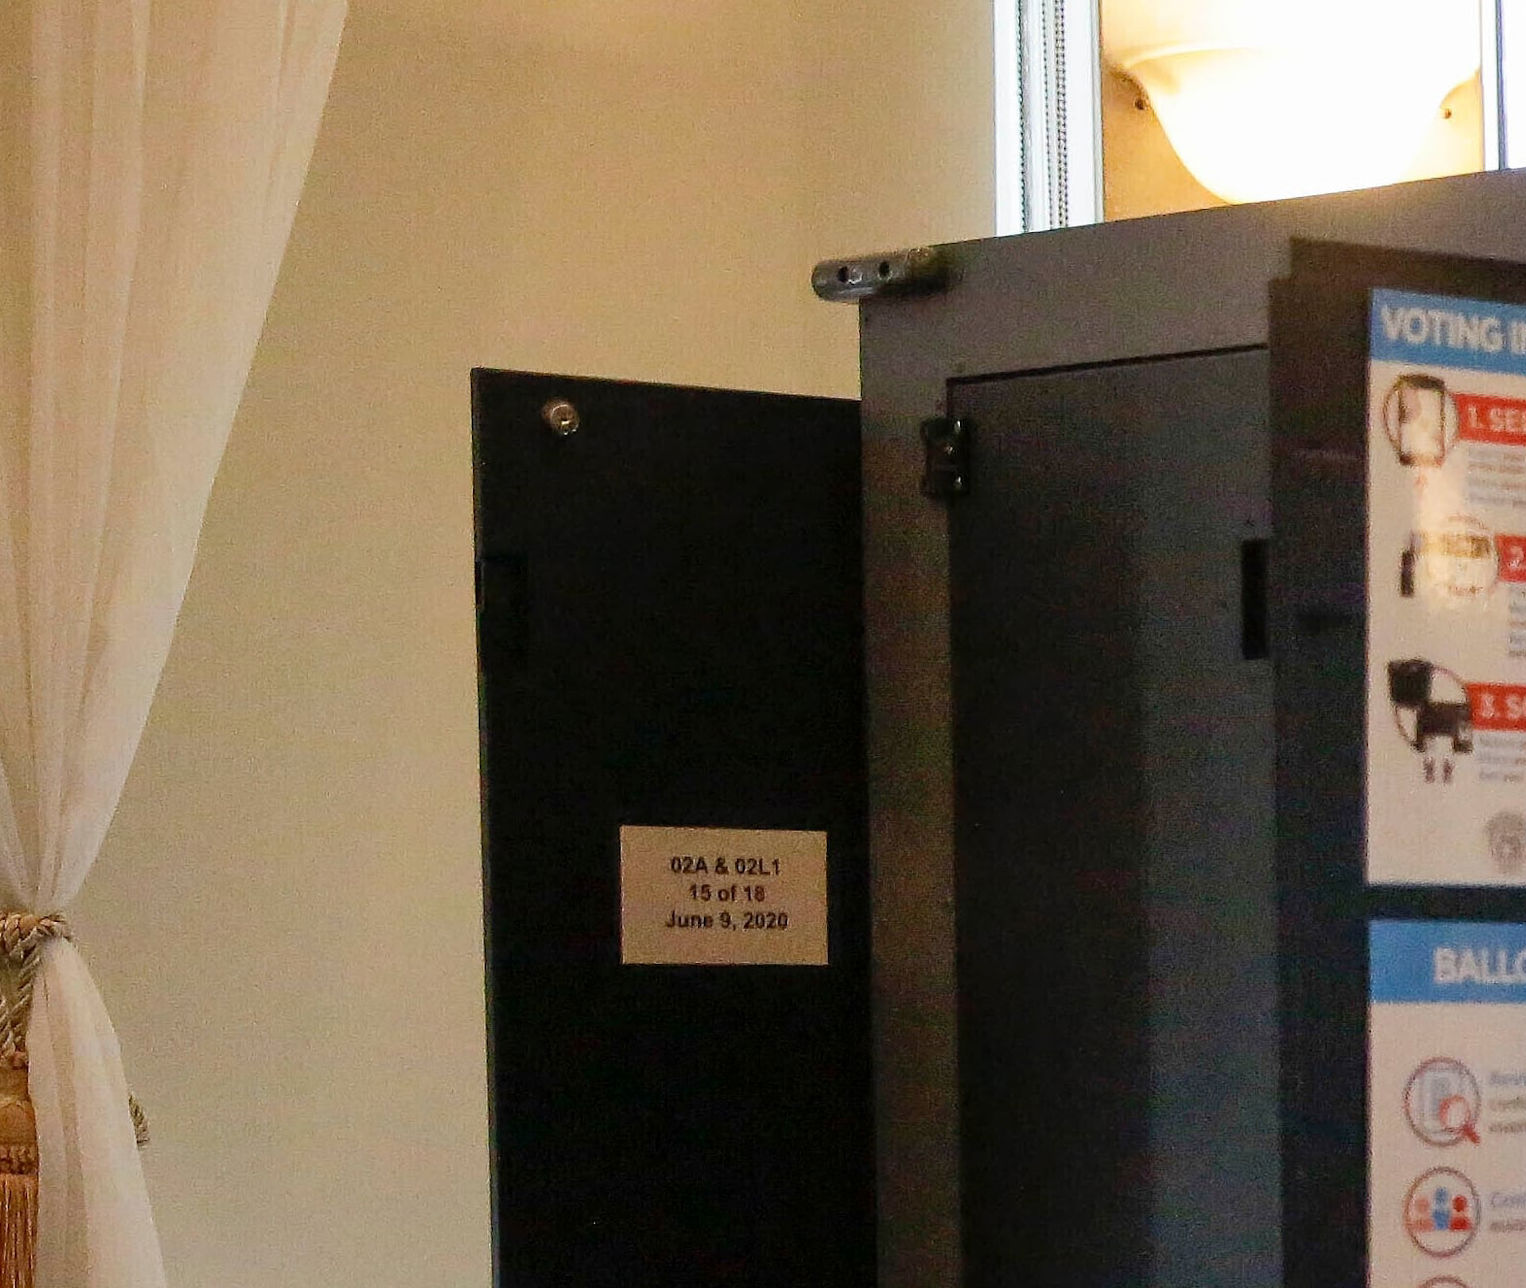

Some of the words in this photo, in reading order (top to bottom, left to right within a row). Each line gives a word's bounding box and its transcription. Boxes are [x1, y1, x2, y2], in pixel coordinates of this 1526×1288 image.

[1380, 304, 1501, 352] VOTING
[670, 856, 708, 874] 02A
[715, 858, 729, 874] &
[735, 858, 780, 875] 02L1
[690, 884, 711, 901] 15
[718, 885, 736, 901] of
[744, 886, 765, 901] 18
[666, 911, 713, 928] June
[719, 912, 736, 930] 9,
[743, 913, 788, 930] 2020
